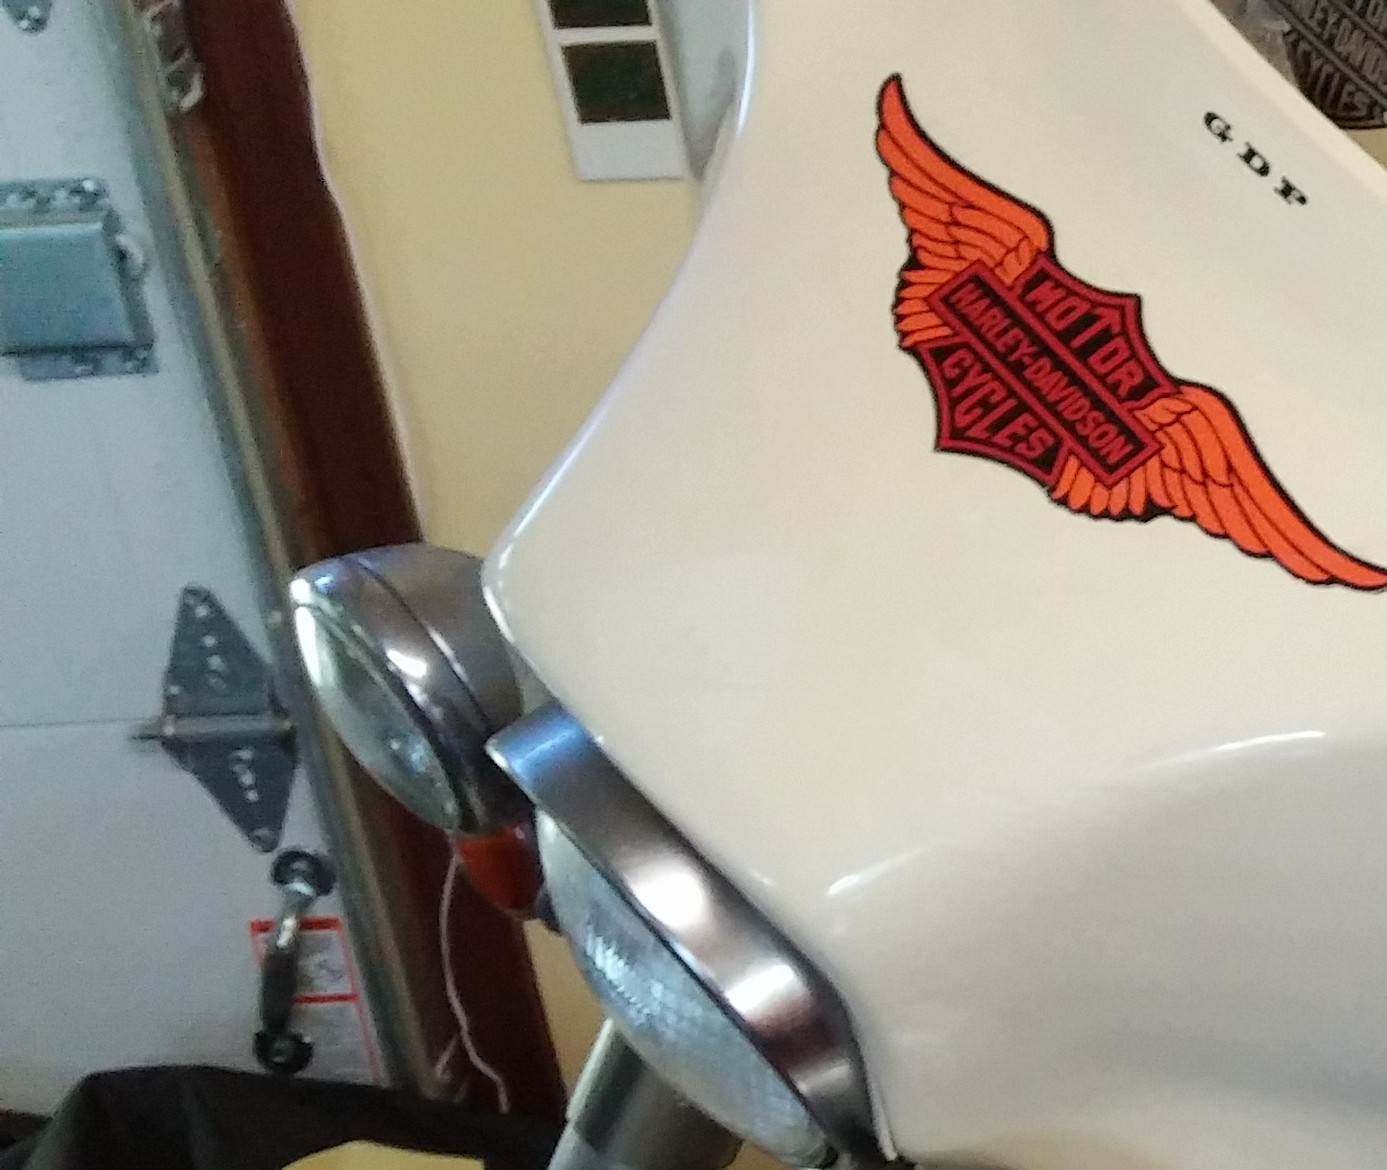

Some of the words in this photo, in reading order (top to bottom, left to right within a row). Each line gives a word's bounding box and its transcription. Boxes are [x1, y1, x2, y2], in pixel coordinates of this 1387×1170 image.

[951, 281, 1134, 465] HARLEY-DAVIDSON
[1023, 278, 1144, 398] MOTOR
[941, 348, 1055, 459] CYCLES
